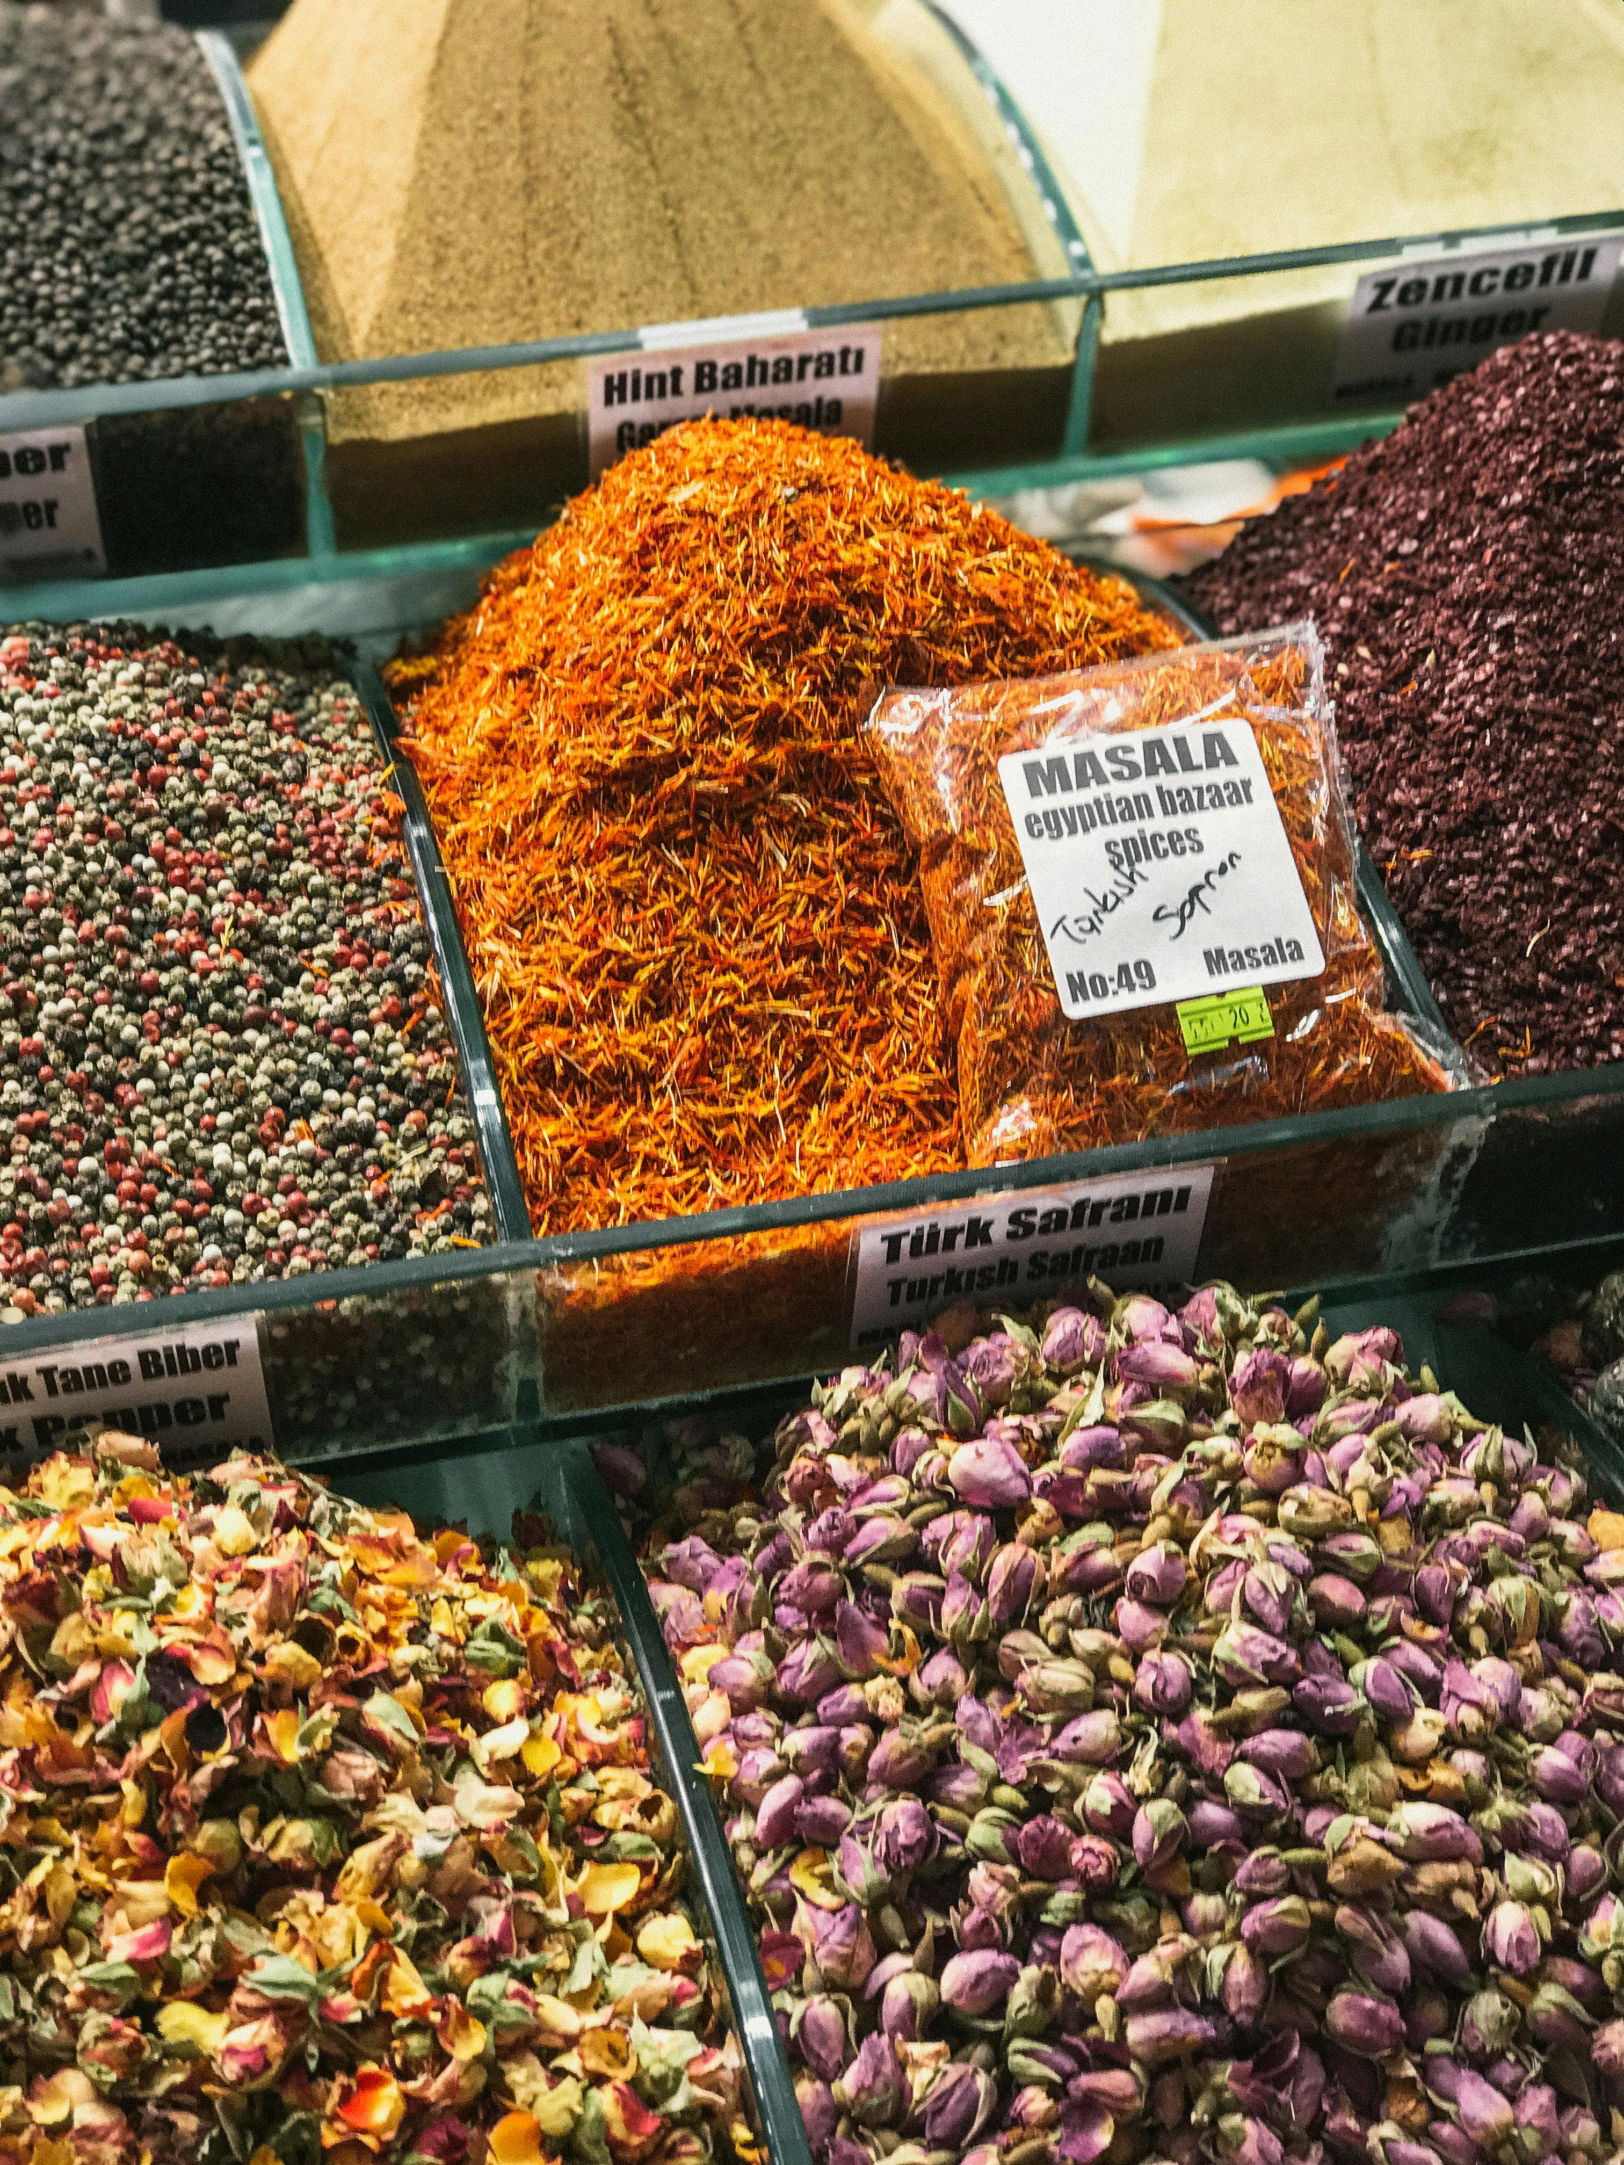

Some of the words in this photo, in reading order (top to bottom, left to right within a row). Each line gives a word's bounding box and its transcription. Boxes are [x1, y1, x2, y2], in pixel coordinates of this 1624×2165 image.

[1366, 247, 1598, 314] Zencefil
[604, 366, 684, 407] Hint
[0, 499, 59, 534] er
[1022, 731, 1239, 798] MASALA
[1024, 791, 1154, 839] egyptian
[1156, 776, 1254, 816] bazaar
[1104, 826, 1204, 867] spices
[1066, 960, 1156, 1004] No:49
[1203, 937, 1304, 977] Masala
[881, 1216, 995, 1265] Türk
[887, 1257, 1019, 1306] Turkish
[36, 1359, 131, 1398] Tane
[137, 1338, 240, 1382] Biber
